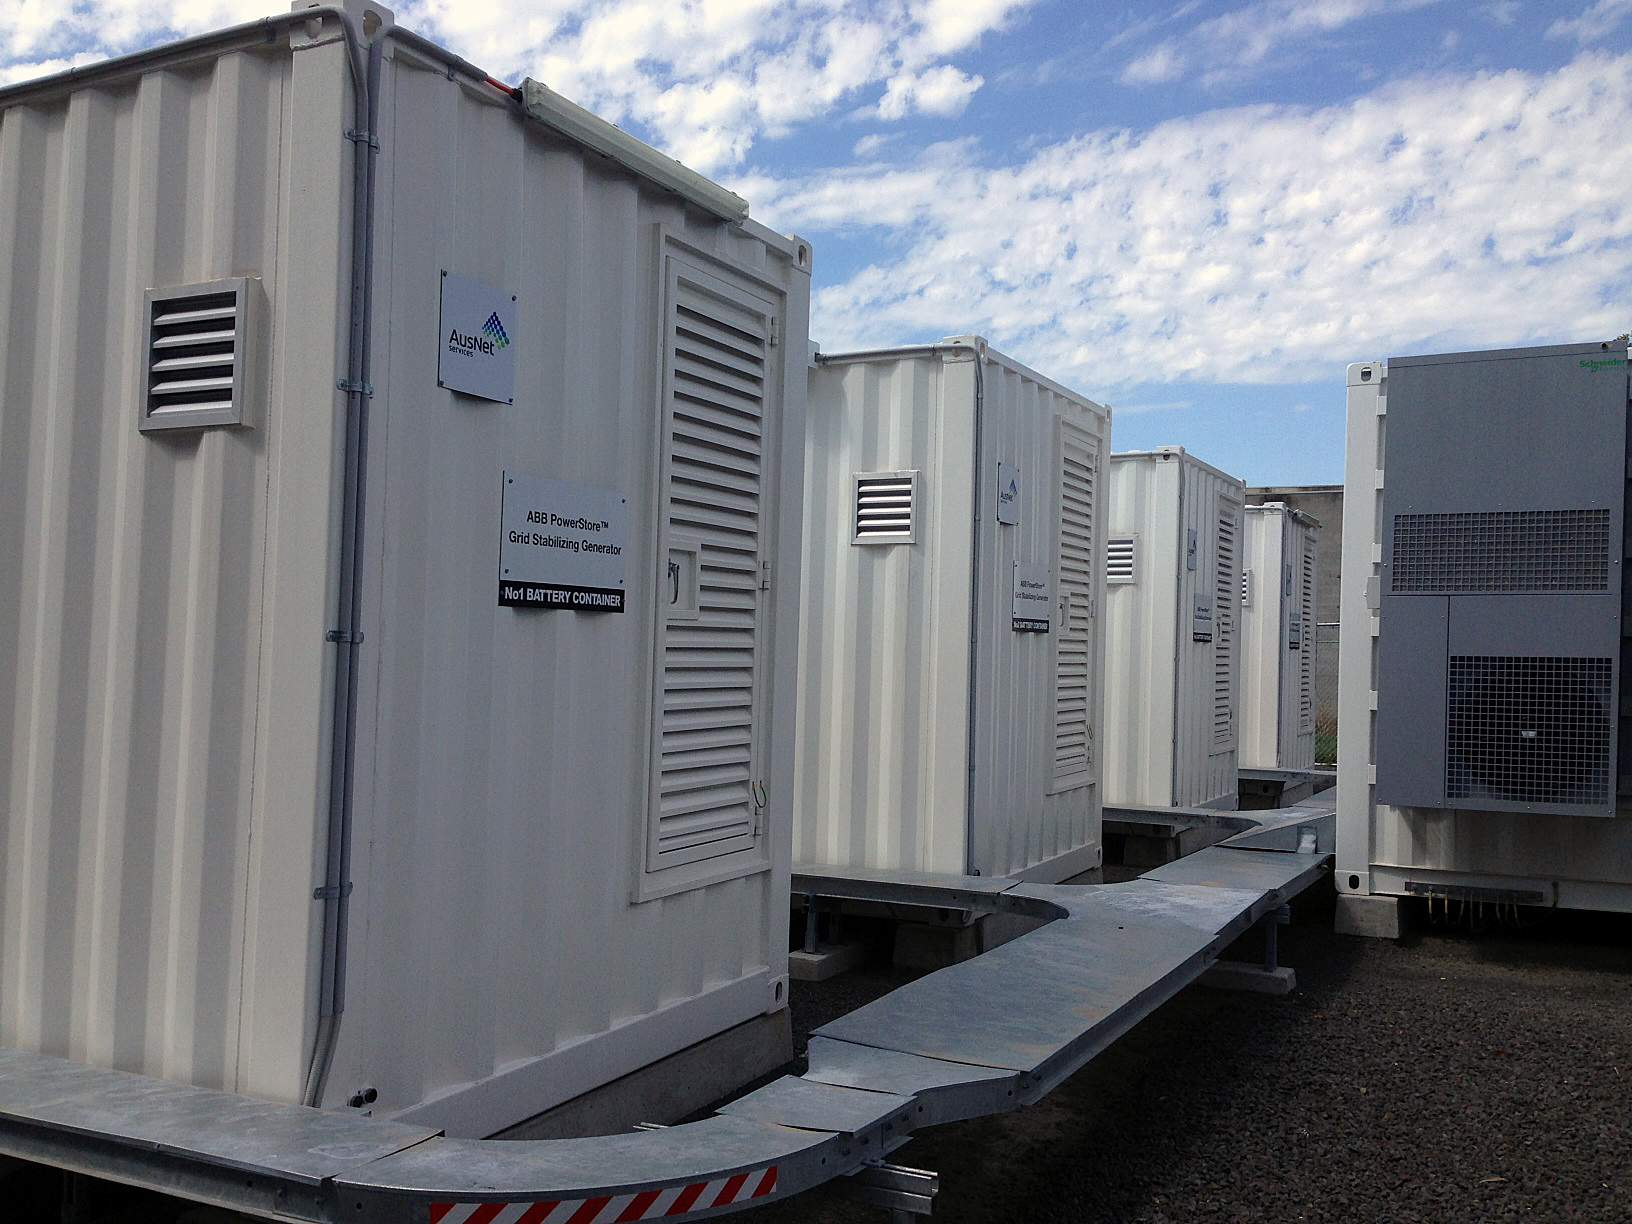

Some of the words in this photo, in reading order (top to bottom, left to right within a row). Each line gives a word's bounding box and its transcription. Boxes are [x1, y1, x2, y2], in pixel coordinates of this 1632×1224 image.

[448, 345, 474, 358] services
[449, 329, 495, 356] AusNet
[526, 510, 548, 525] ABB
[509, 530, 530, 545] Grid
[532, 533, 579, 552] Stabilizing
[581, 539, 622, 555] Generator
[504, 586, 524, 600] No1
[526, 588, 571, 603] BATTERY
[572, 592, 621, 607] CONTAINER
